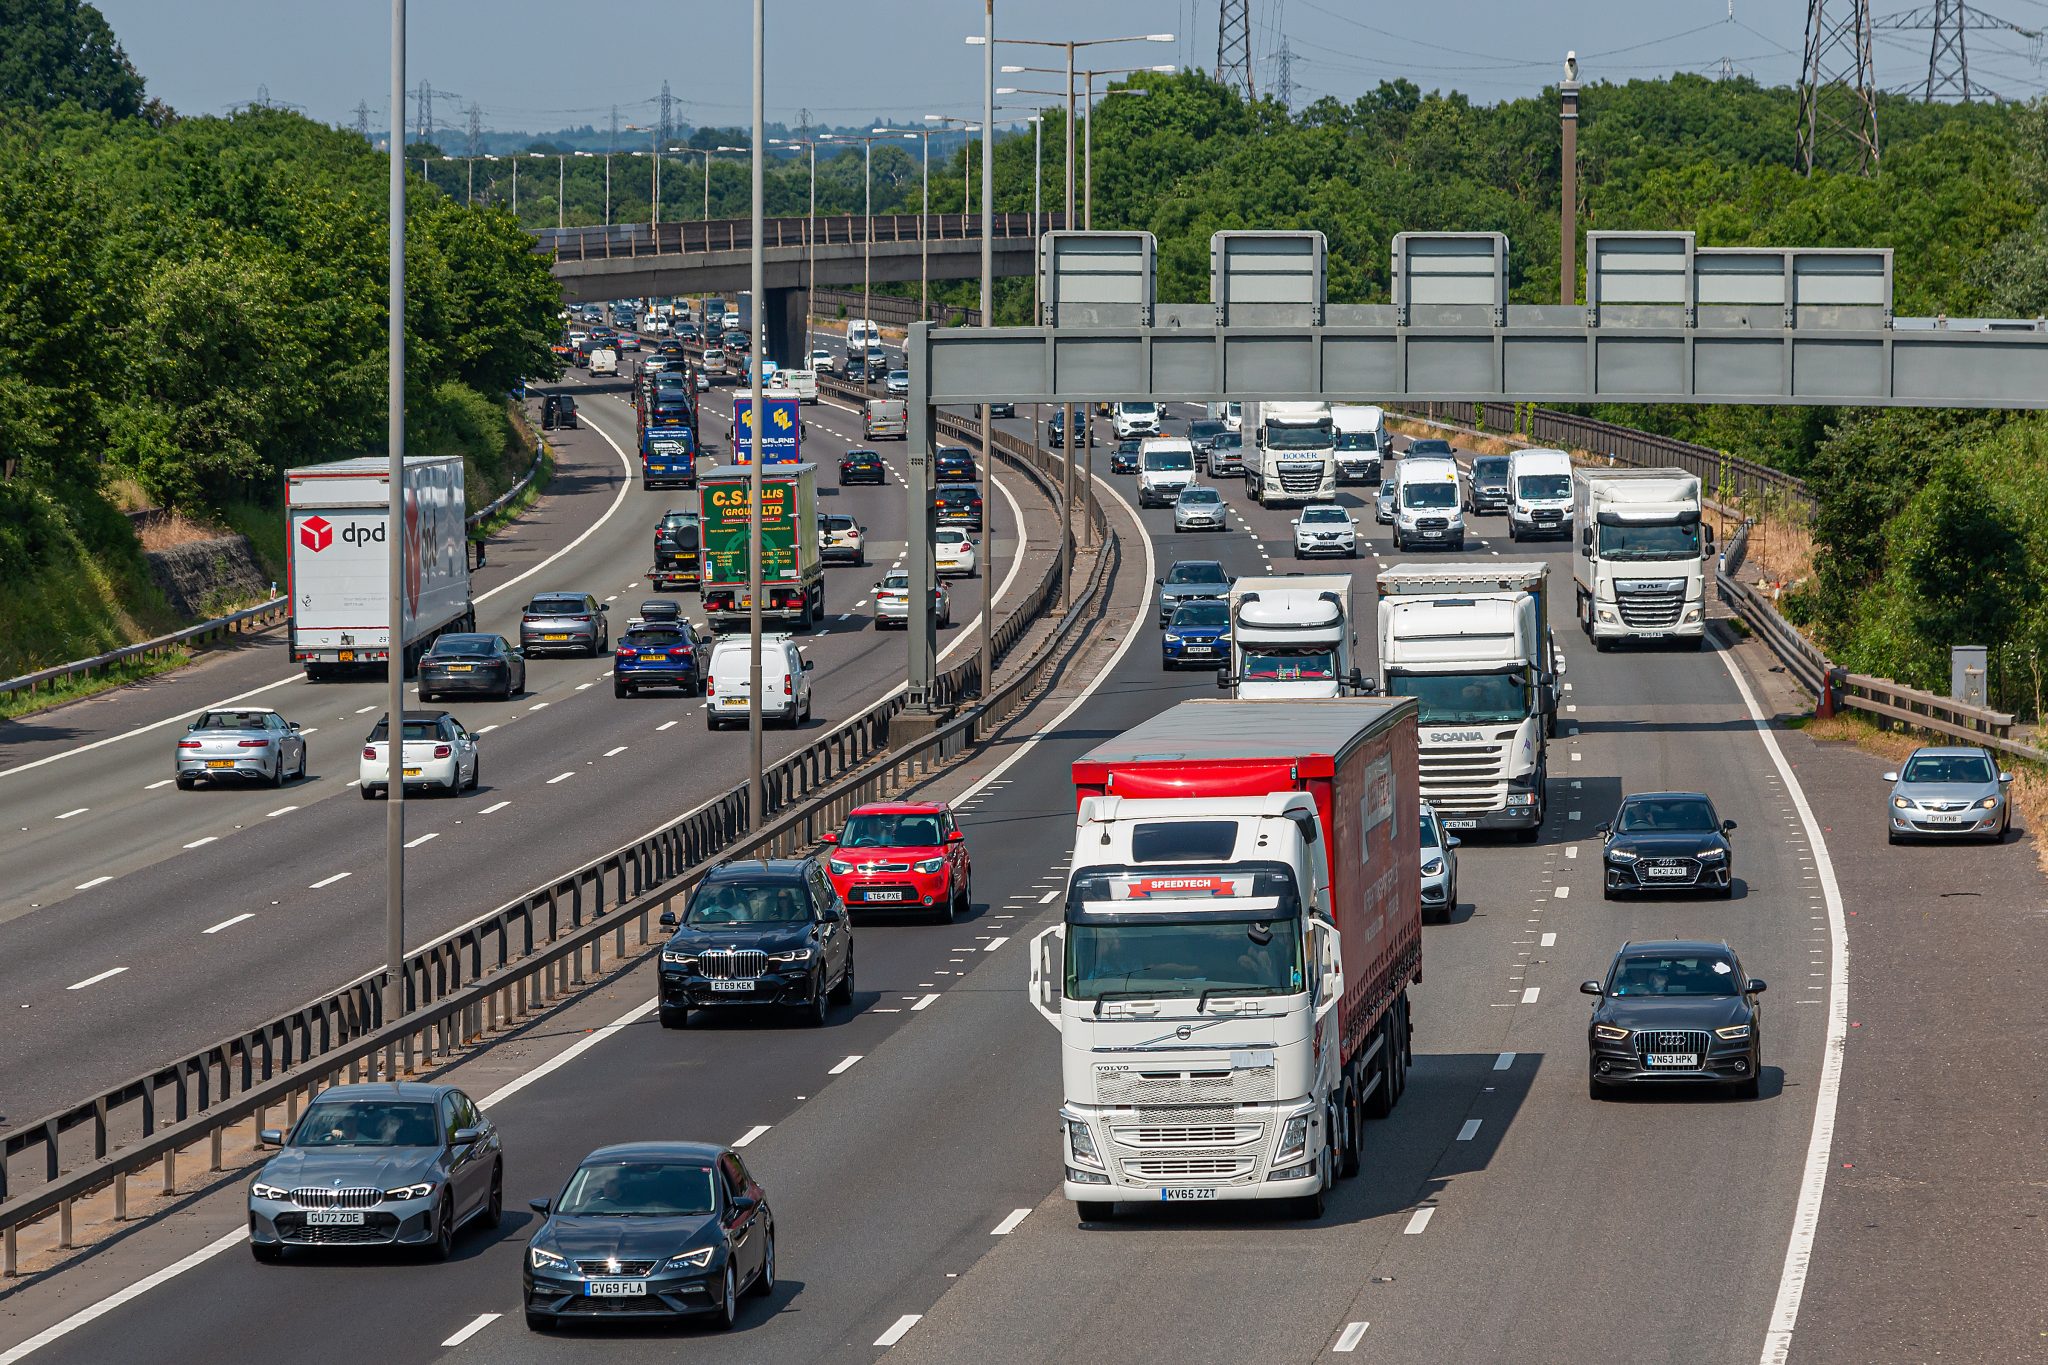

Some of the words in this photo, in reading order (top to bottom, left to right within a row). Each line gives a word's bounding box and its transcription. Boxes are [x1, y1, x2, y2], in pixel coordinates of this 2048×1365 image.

[1283, 452, 1317, 460] BOOKER
[761, 505, 783, 515] LTD
[342, 521, 386, 548] dpd
[422, 508, 437, 584] dpd
[1430, 731, 1484, 743] SCANIA
[1444, 820, 1461, 828] FX67
[1461, 820, 1474, 828] NNJ
[1151, 879, 1211, 889] SPEEDTECH
[867, 892, 886, 900] LT64
[887, 891, 900, 899] PXE
[714, 981, 735, 990] ET69
[736, 981, 752, 989] KEK
[1651, 1055, 1674, 1064] VN63
[1675, 1054, 1693, 1063] HPK
[1168, 1189, 1194, 1199] KV65
[1196, 1188, 1216, 1198] ZZT
[310, 1213, 338, 1223] GU72
[339, 1212, 359, 1222] ZDE
[591, 1283, 620, 1294] GV69
[622, 1282, 643, 1293] FLA
